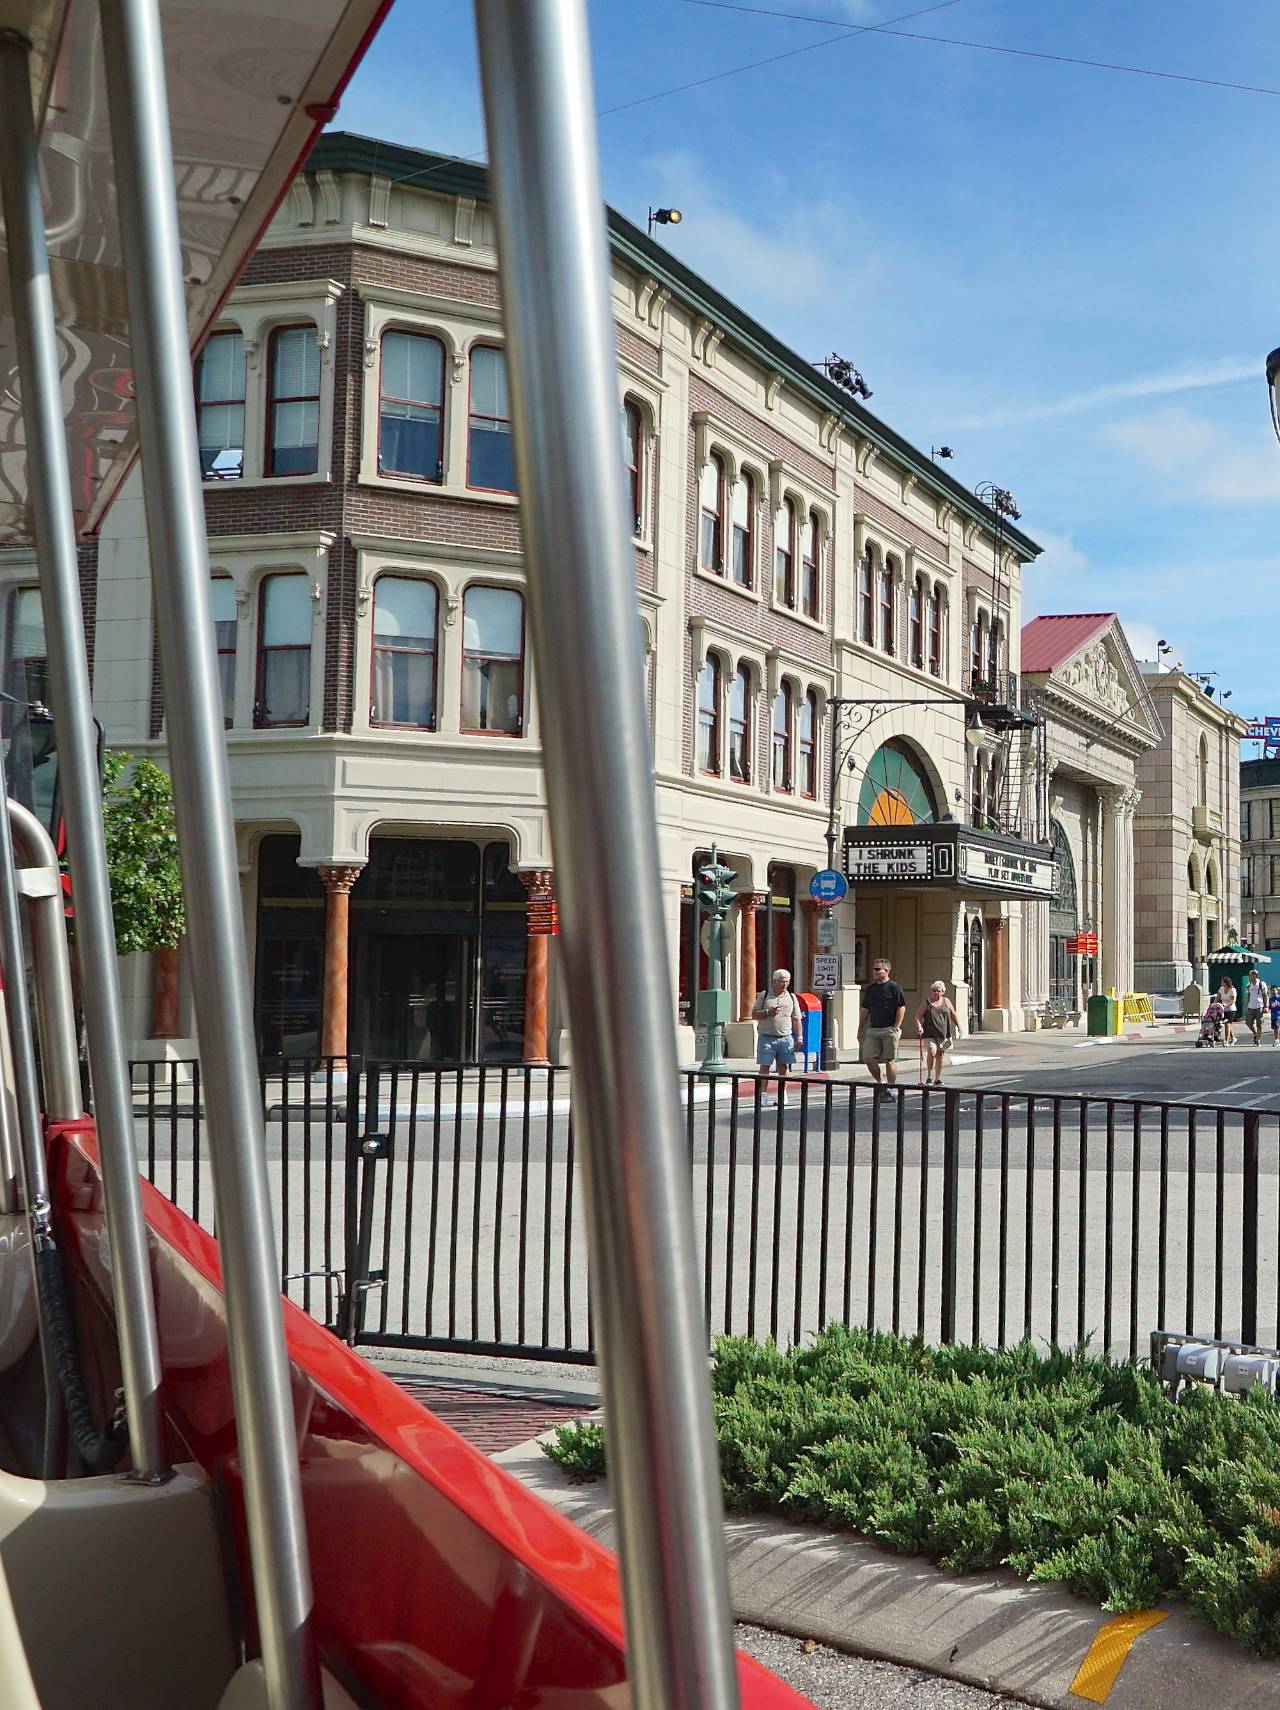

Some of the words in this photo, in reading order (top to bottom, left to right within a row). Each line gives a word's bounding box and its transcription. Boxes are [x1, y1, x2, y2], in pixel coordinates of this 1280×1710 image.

[858, 849, 863, 860] I
[867, 848, 916, 860] SHRUNK
[855, 863, 880, 874] THE
[887, 862, 917, 873] KIDS
[814, 974, 836, 986] 25
